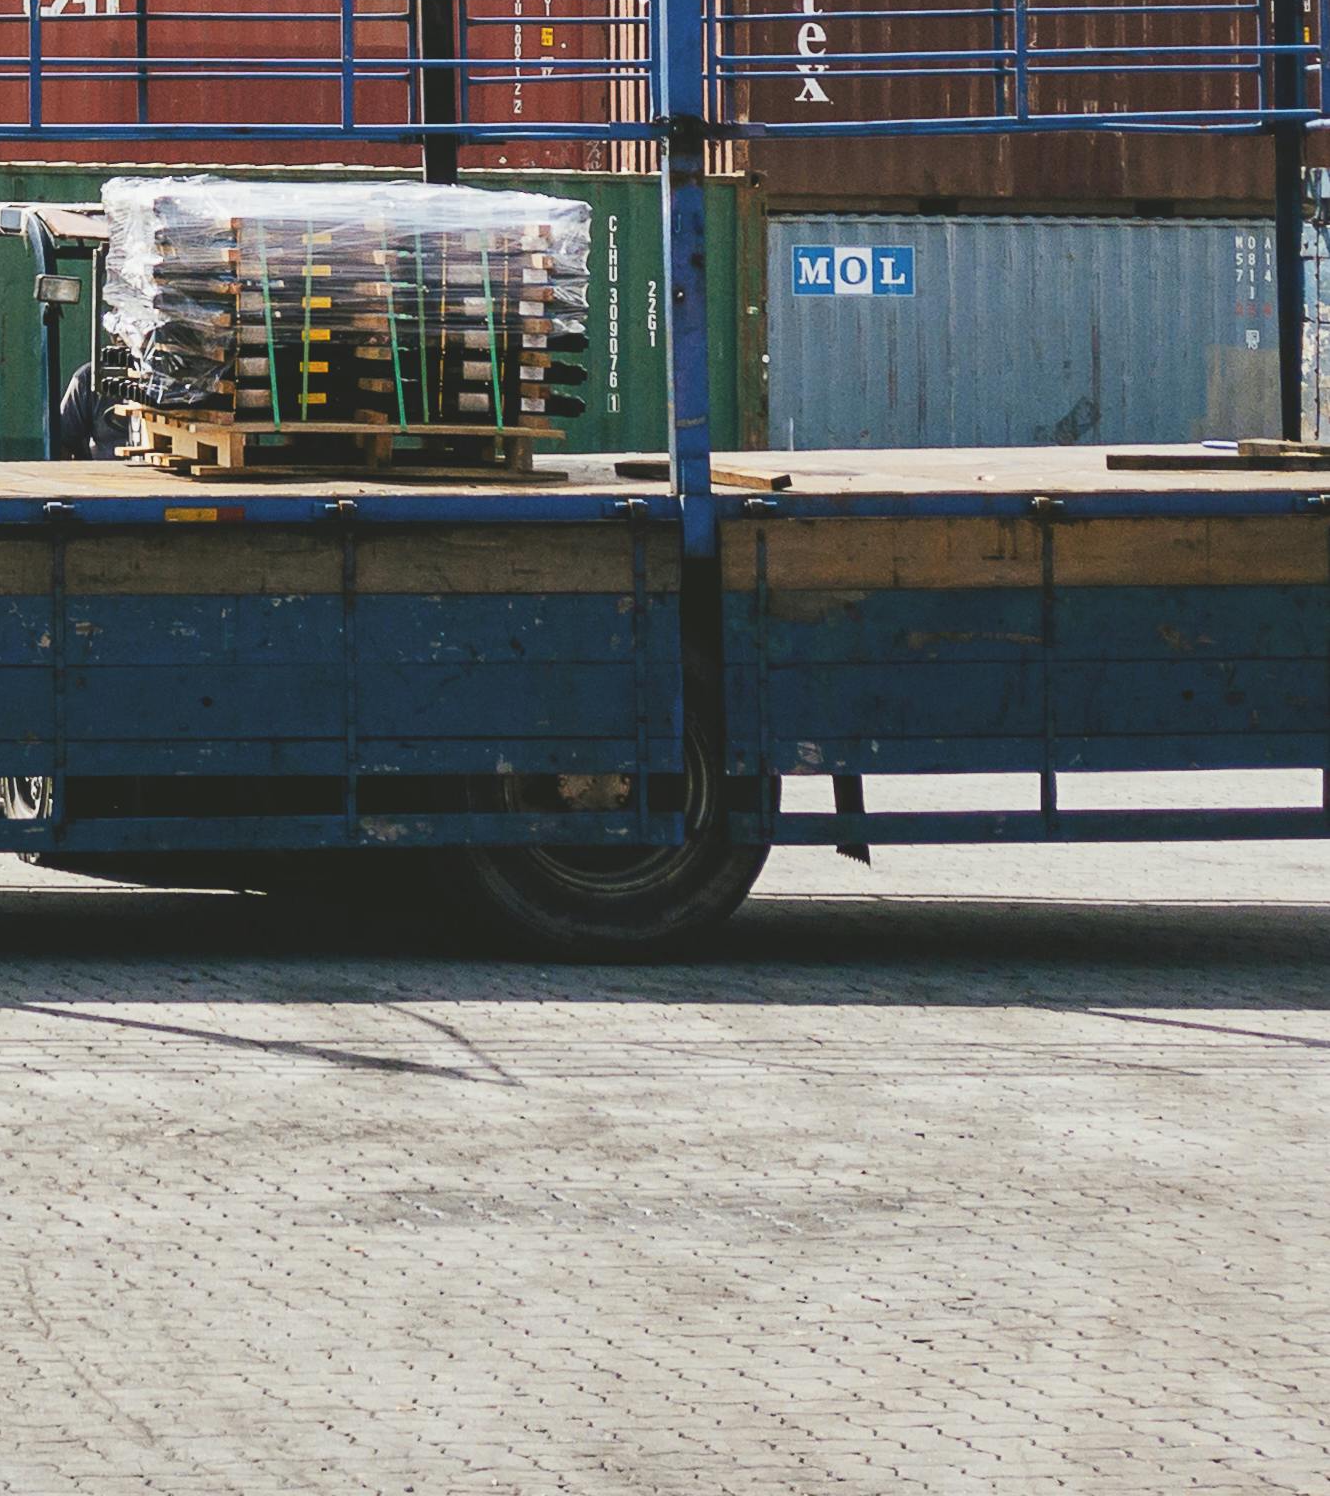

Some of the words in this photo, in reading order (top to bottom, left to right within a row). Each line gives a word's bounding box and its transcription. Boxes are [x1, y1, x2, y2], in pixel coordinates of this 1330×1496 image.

[608, 215, 618, 283] CLHU
[798, 256, 906, 285] MOL
[1235, 236, 1272, 249] MOA
[609, 287, 618, 388] 309076
[647, 280, 657, 347] 22G1
